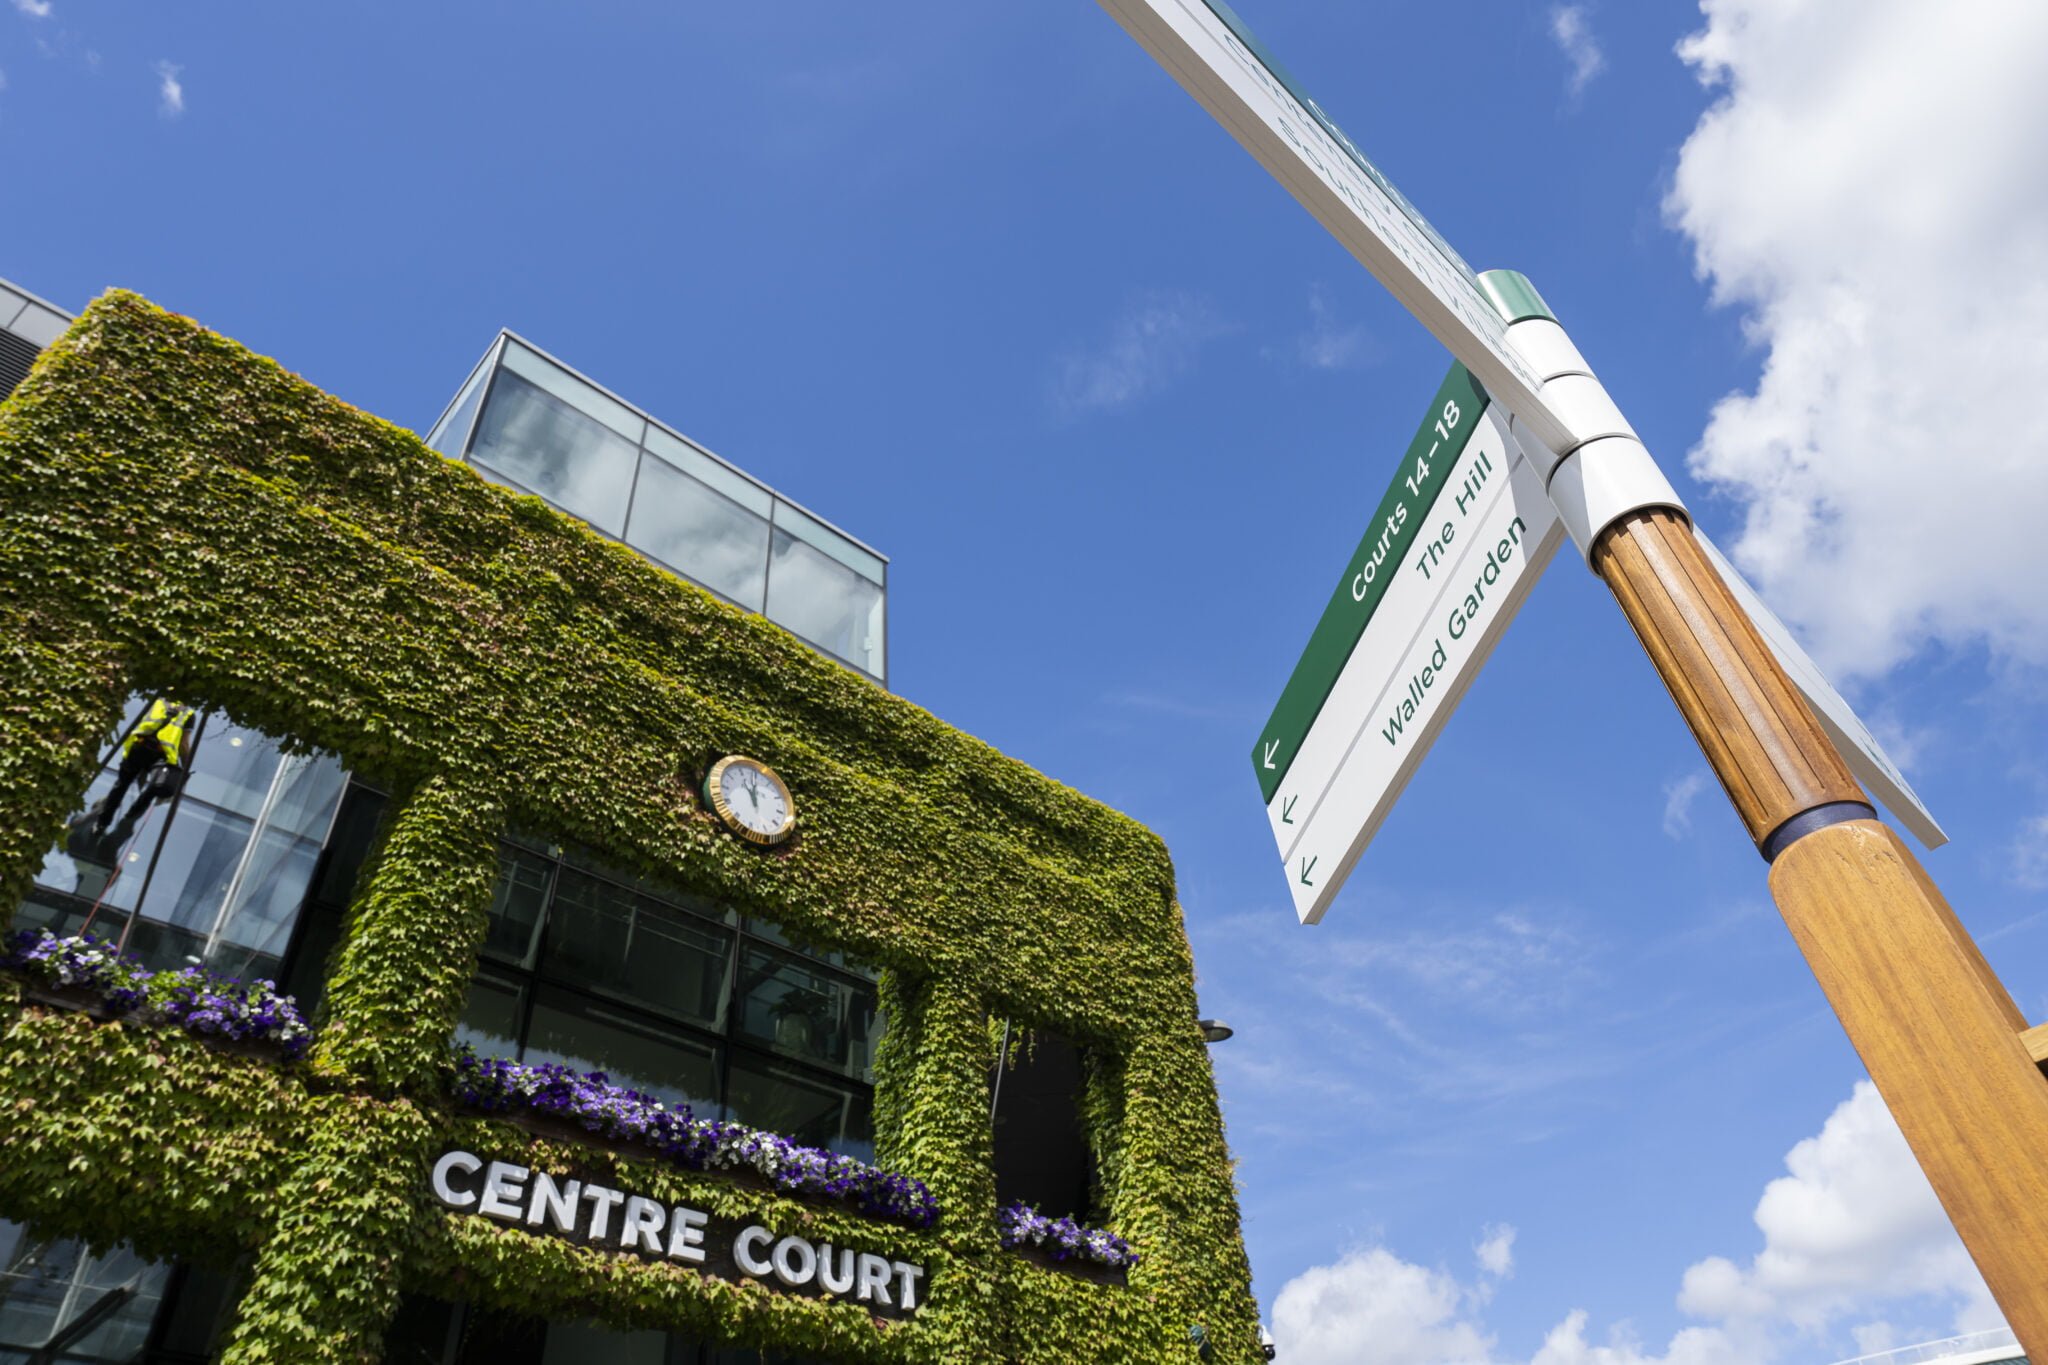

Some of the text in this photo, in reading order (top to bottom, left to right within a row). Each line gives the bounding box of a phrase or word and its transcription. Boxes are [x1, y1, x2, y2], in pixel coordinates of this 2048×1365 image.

[1223, 33, 1391, 216] Centenary
[1307, 97, 1406, 207] Courts
[1277, 116, 1541, 393] Southern Village
[1352, 502, 1407, 602] Courts
[1415, 450, 1493, 582] The Hill
[1381, 515, 1526, 747] Walled Garden
[432, 1150, 925, 1312] CENTRE COURT
